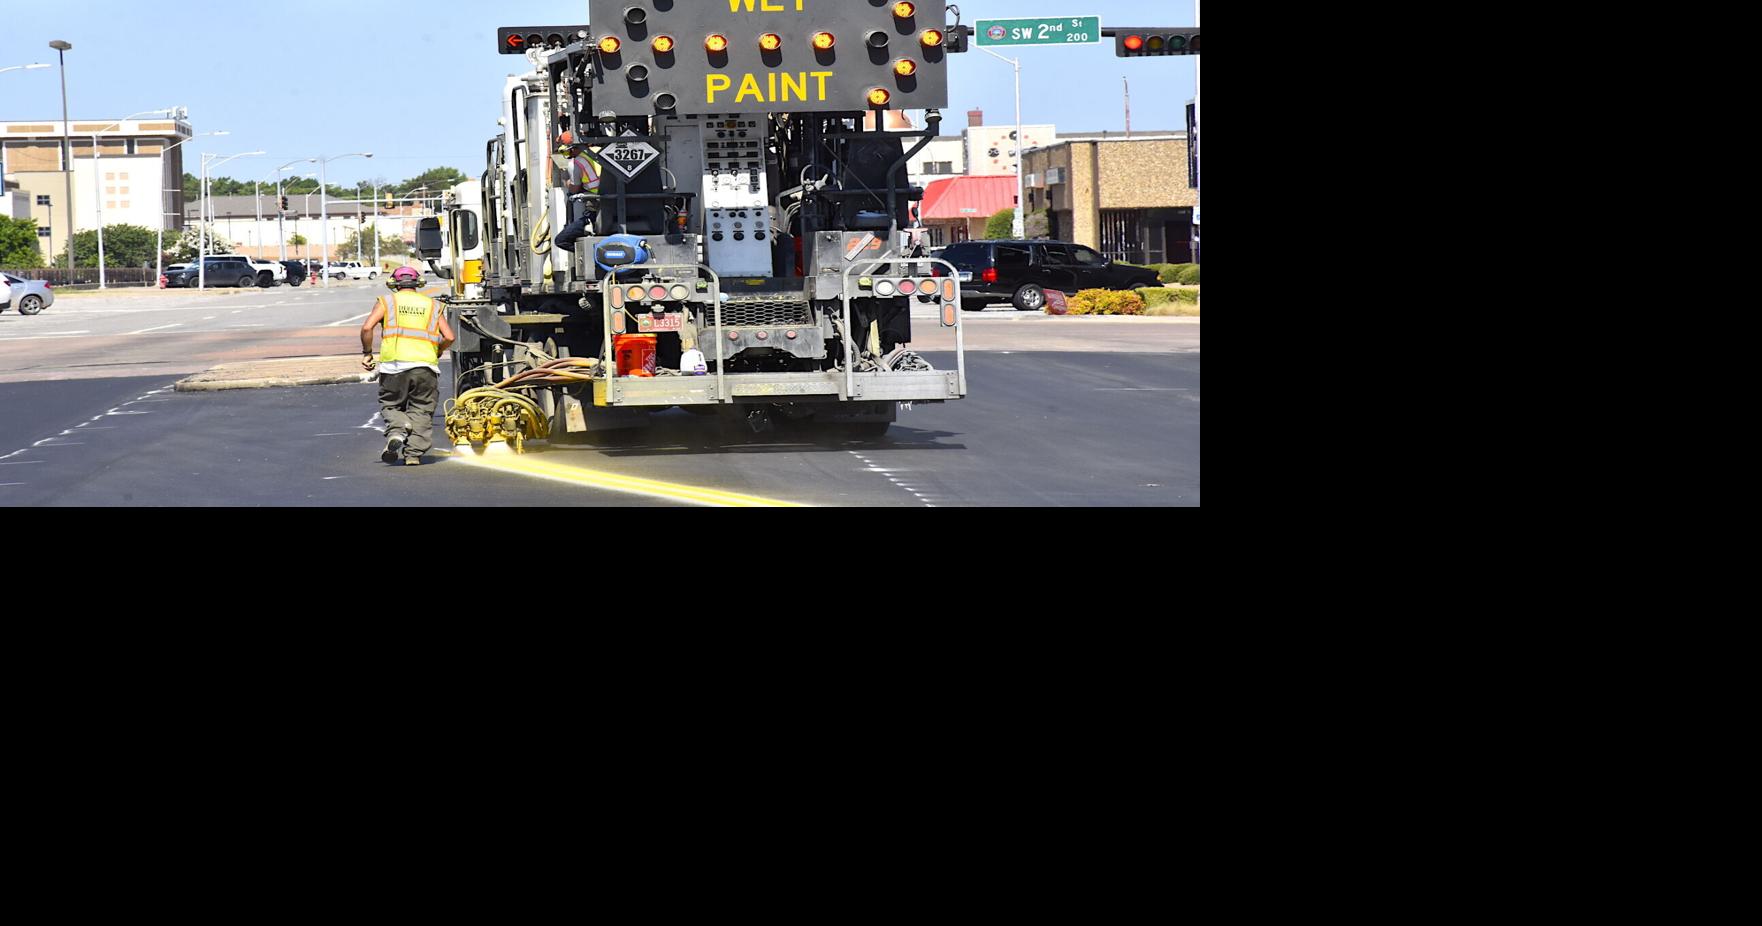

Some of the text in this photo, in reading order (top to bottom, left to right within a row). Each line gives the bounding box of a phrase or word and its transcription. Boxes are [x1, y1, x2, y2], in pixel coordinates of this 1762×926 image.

[1012, 19, 1082, 40] SW 2nd St
[1066, 33, 1088, 42] 200
[706, 71, 833, 104] PAINT
[614, 149, 644, 160] 3267
